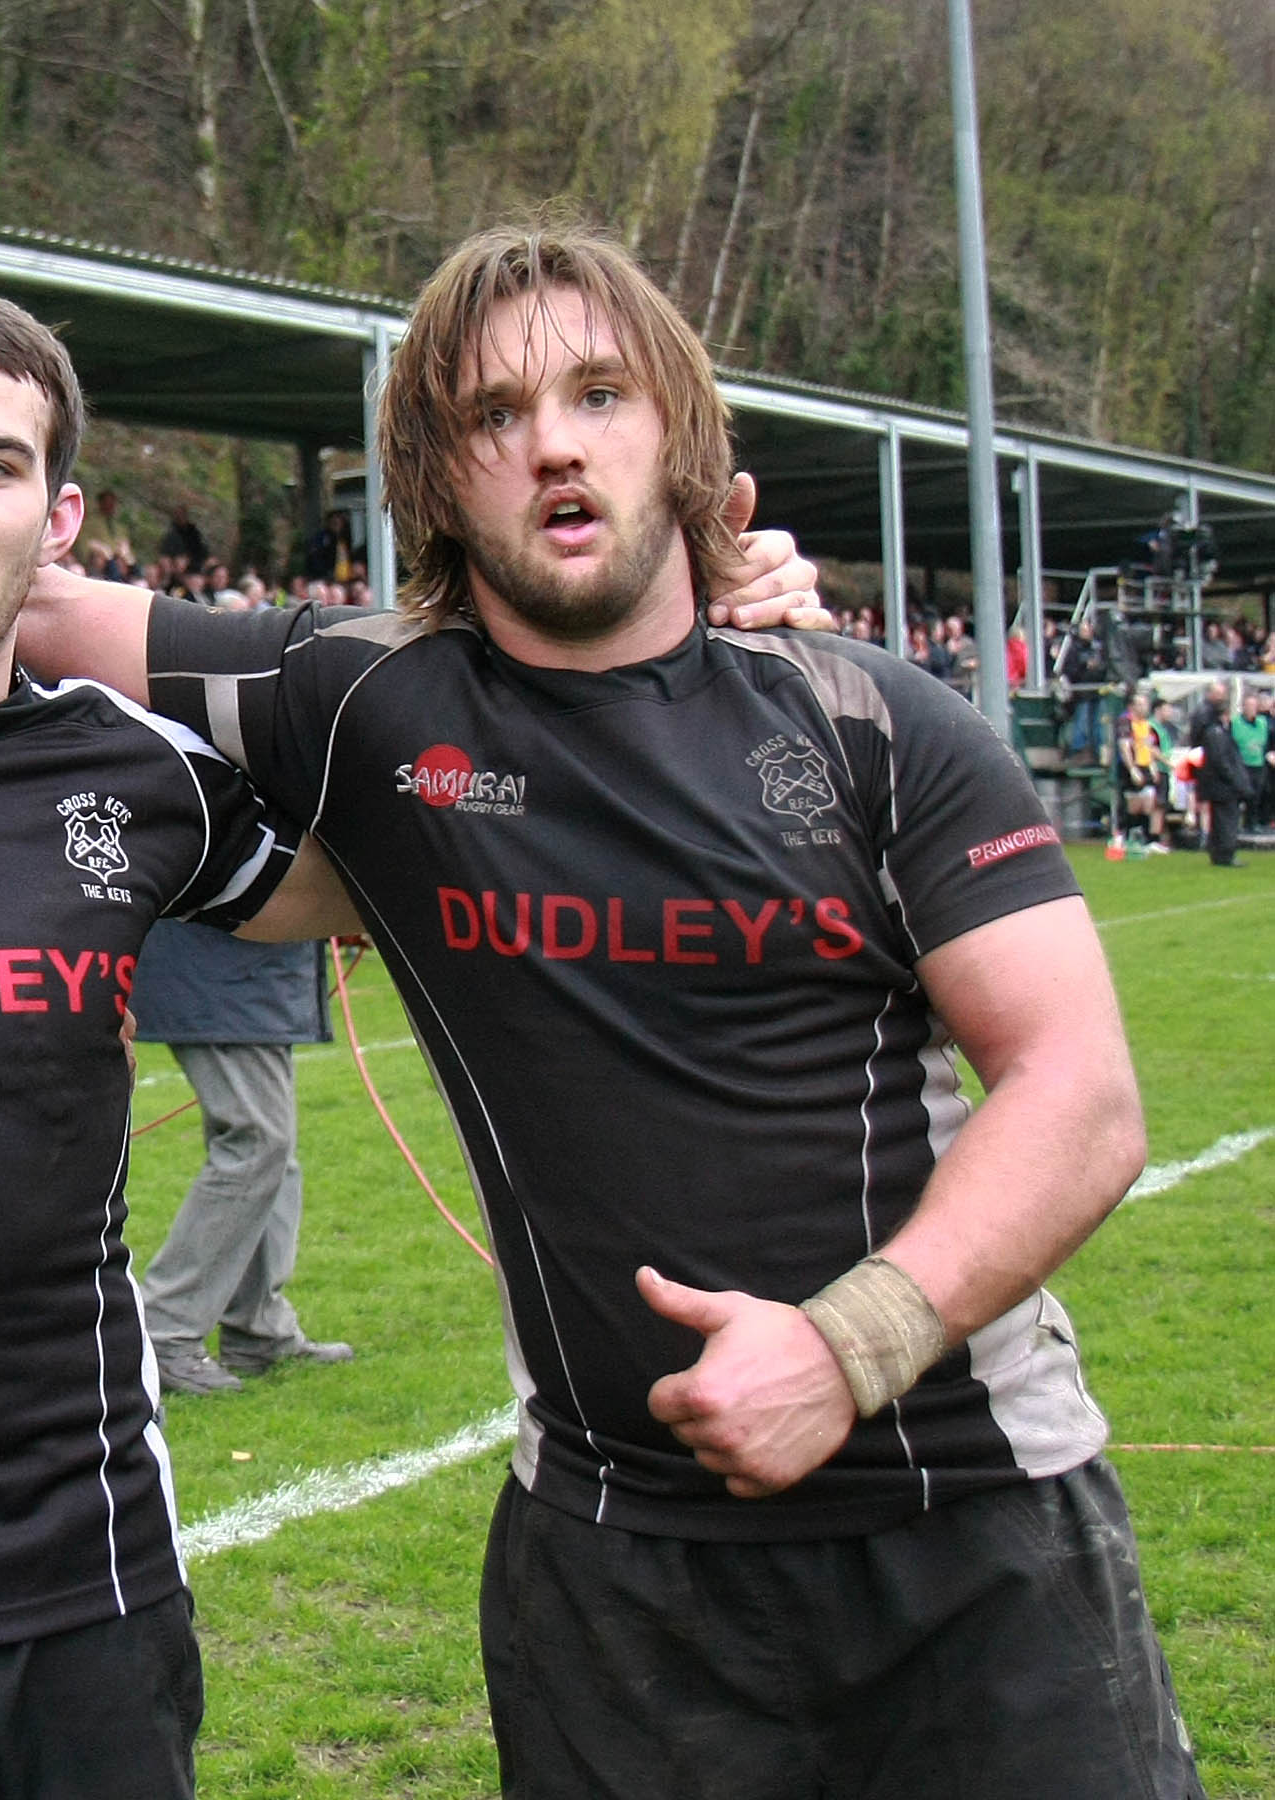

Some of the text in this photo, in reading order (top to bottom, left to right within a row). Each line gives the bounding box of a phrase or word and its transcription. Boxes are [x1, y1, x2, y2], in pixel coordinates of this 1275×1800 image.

[745, 734, 786, 767] CROSS
[395, 764, 525, 804] SAMURAI
[56, 792, 132, 824] CROSS KEYS
[454, 801, 525, 816] RUGBY GEAR
[781, 829, 841, 847] THE KEYS
[80, 883, 132, 904] THE KEYS
[436, 886, 865, 965] DUDLEY'S
